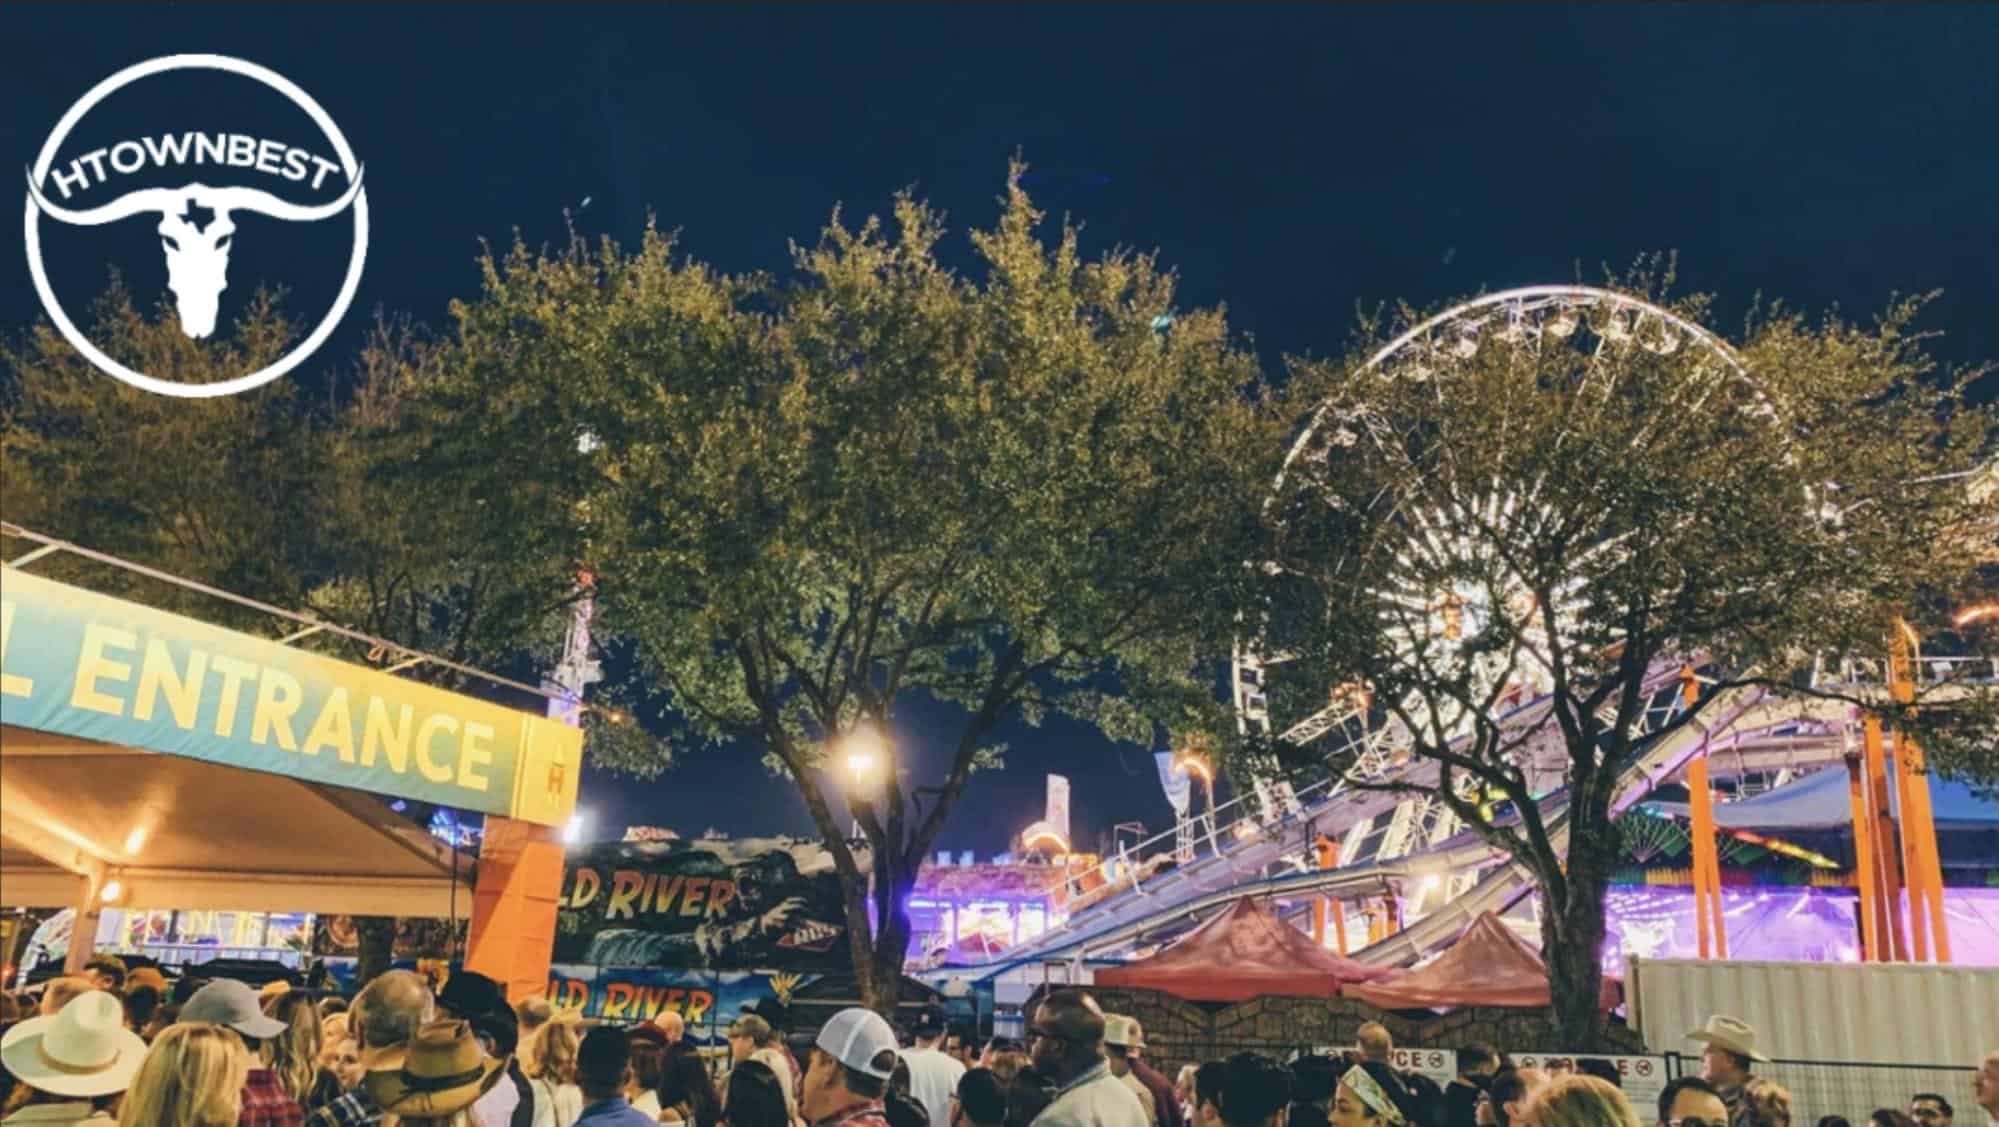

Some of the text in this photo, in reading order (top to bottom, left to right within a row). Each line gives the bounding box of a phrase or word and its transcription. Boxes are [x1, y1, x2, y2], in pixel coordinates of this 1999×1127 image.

[69, 622, 495, 791] ENTRANCE
[605, 869, 737, 920] RIVER
[602, 982, 714, 1025] RIVER
